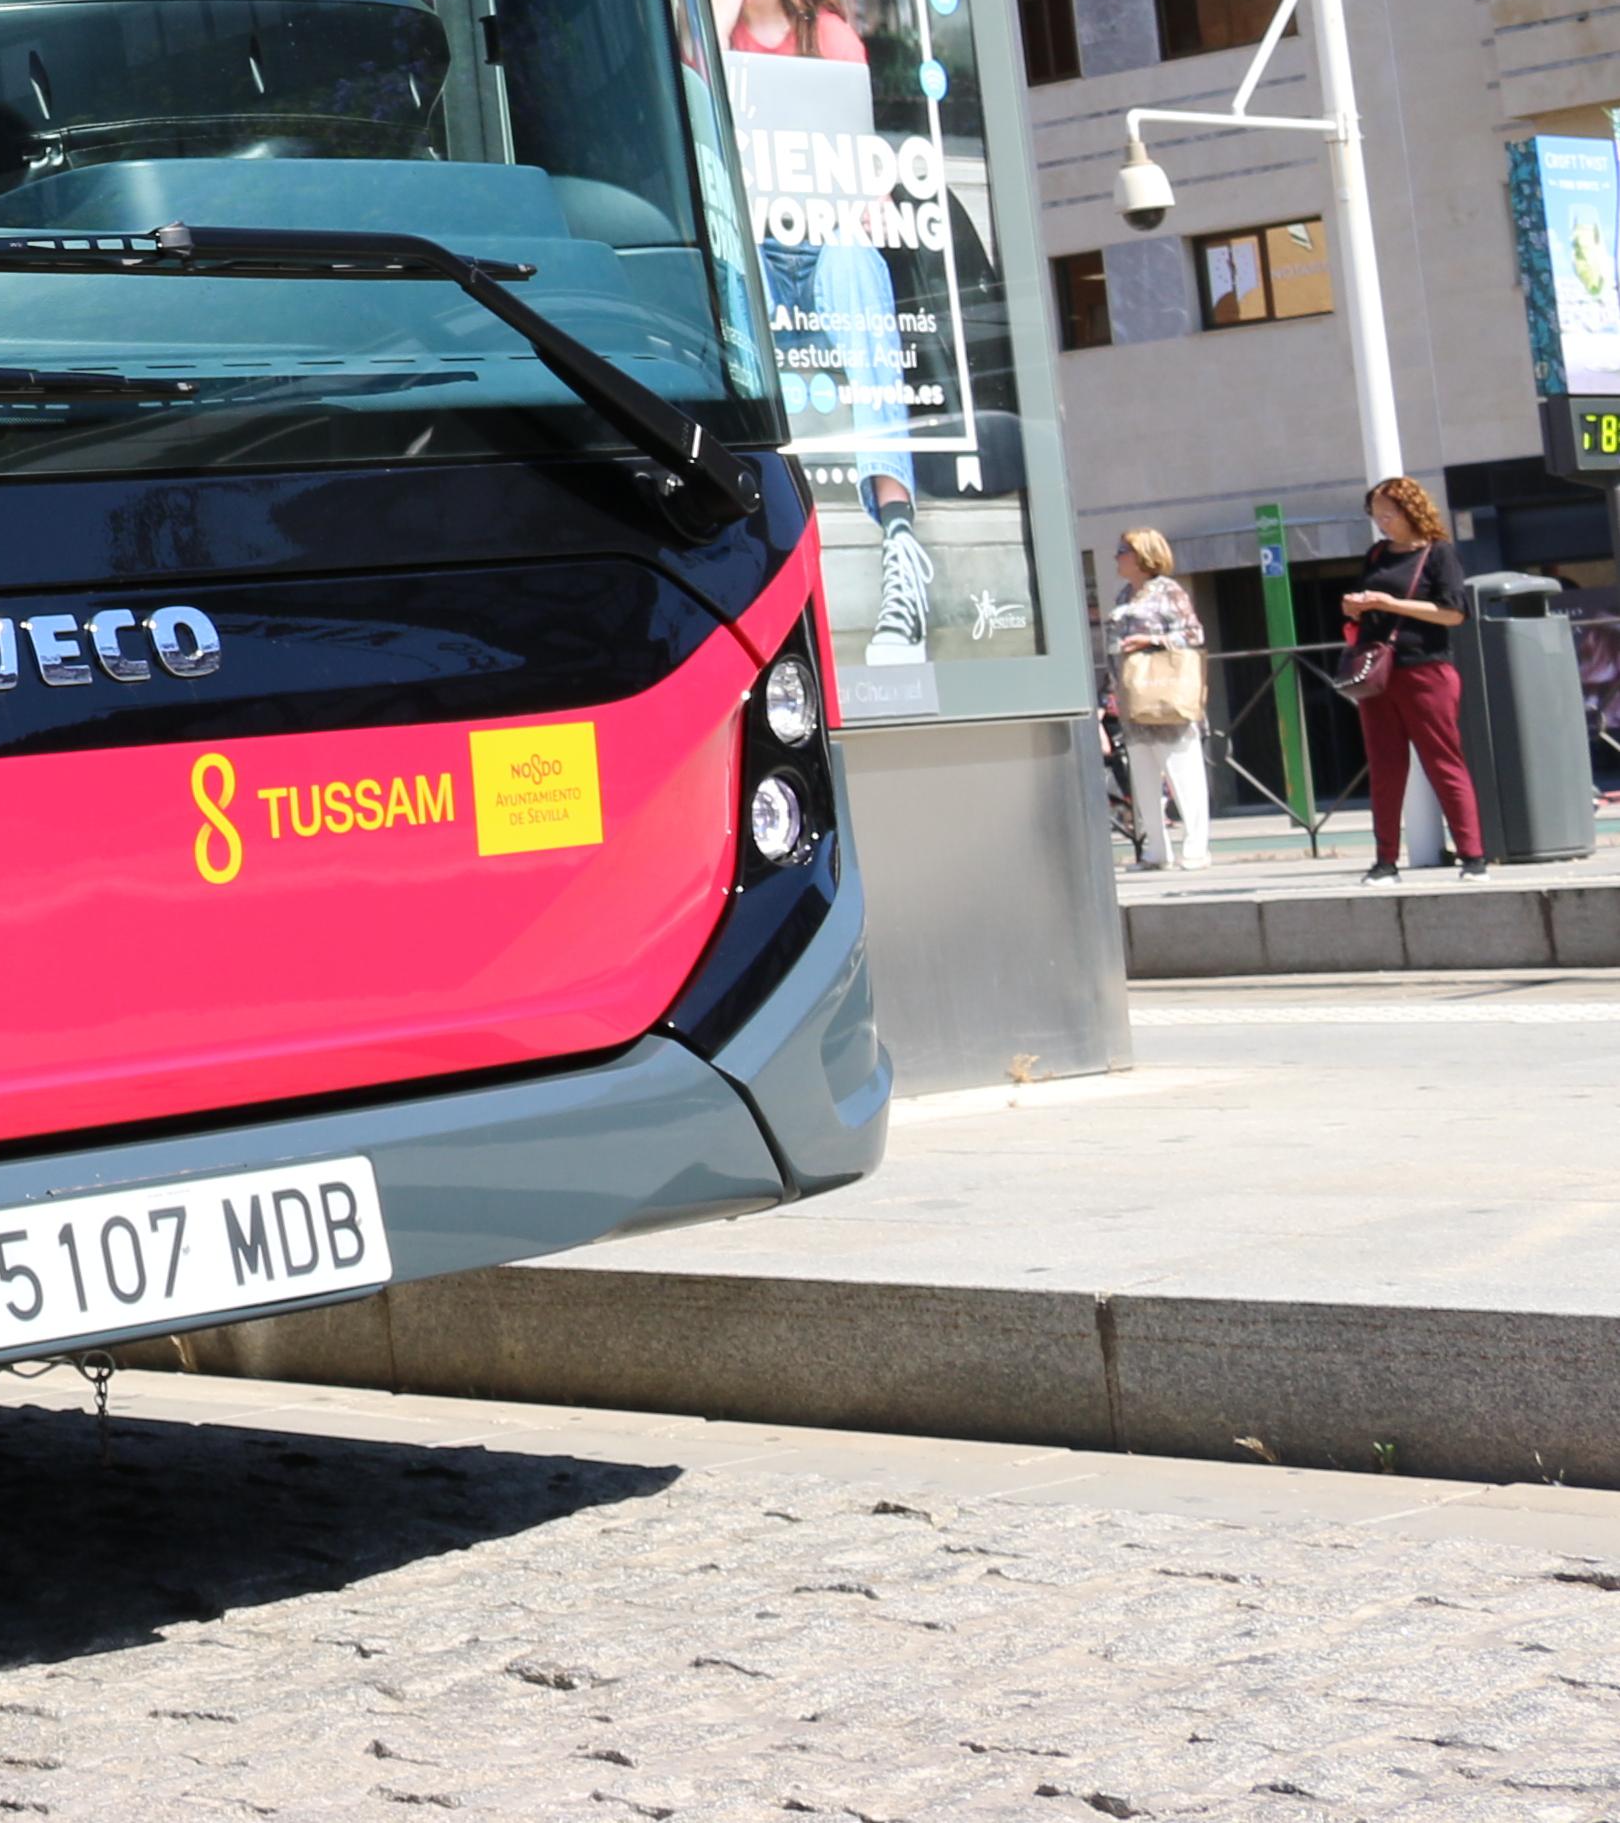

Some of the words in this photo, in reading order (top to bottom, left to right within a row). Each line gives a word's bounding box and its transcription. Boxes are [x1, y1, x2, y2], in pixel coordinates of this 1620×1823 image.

[794, 306, 849, 332] haces
[852, 307, 896, 337] algo
[898, 308, 937, 333] más
[788, 344, 870, 368] estudiar.
[873, 343, 918, 375] Aquí
[838, 379, 945, 411] uloyola.es
[1260, 548, 1273, 574] P
[257, 773, 455, 839] TUSSAM
[221, 1180, 367, 1288] MDB
